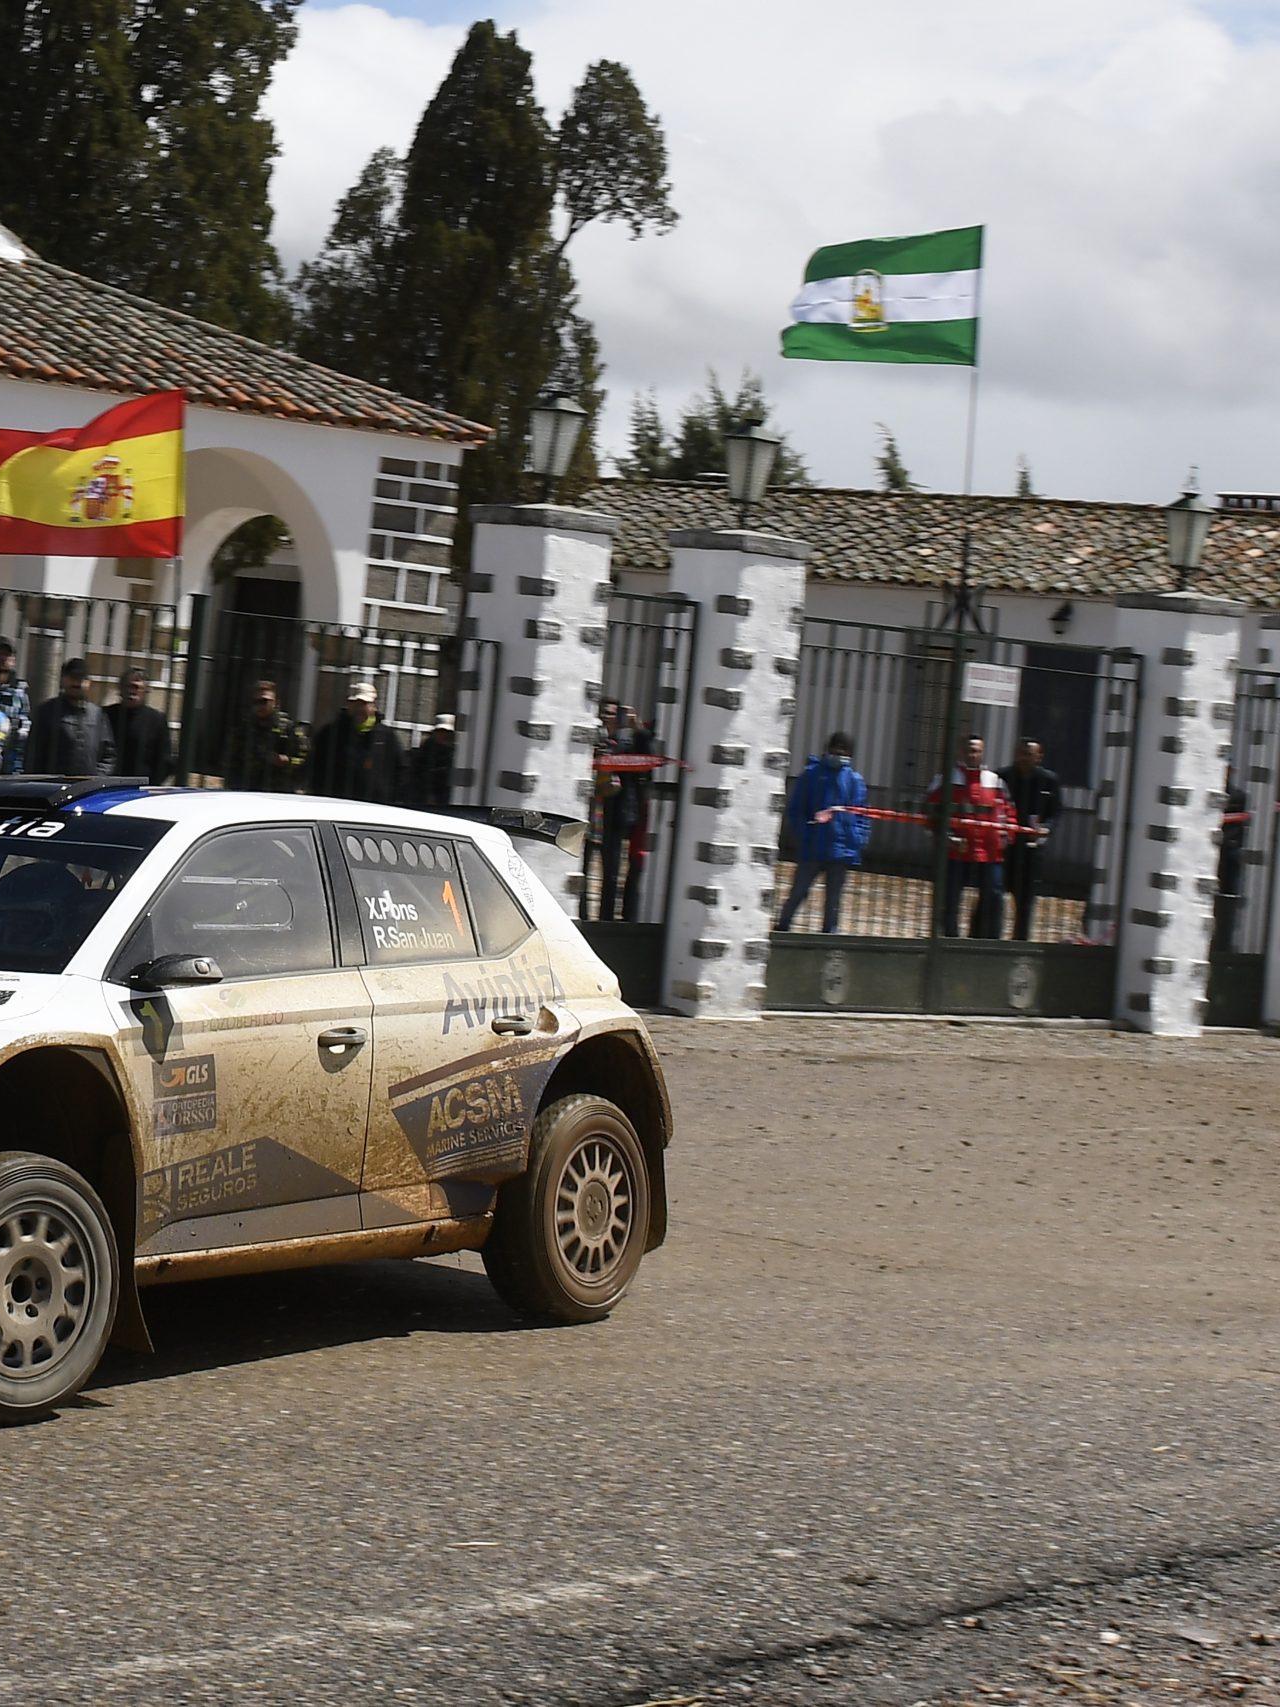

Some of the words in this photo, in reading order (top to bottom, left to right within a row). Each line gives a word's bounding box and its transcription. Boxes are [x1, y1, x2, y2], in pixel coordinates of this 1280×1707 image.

[364, 897, 419, 921] X.Pons
[442, 880, 465, 937] 1
[373, 926, 417, 948] R.San
[419, 927, 455, 949] Juan
[441, 953, 566, 1036] Avintia
[186, 1063, 209, 1085] GLS
[427, 1073, 526, 1137] ACSM
[178, 1143, 257, 1190] REALE
[176, 1173, 257, 1212] SEGUROS
